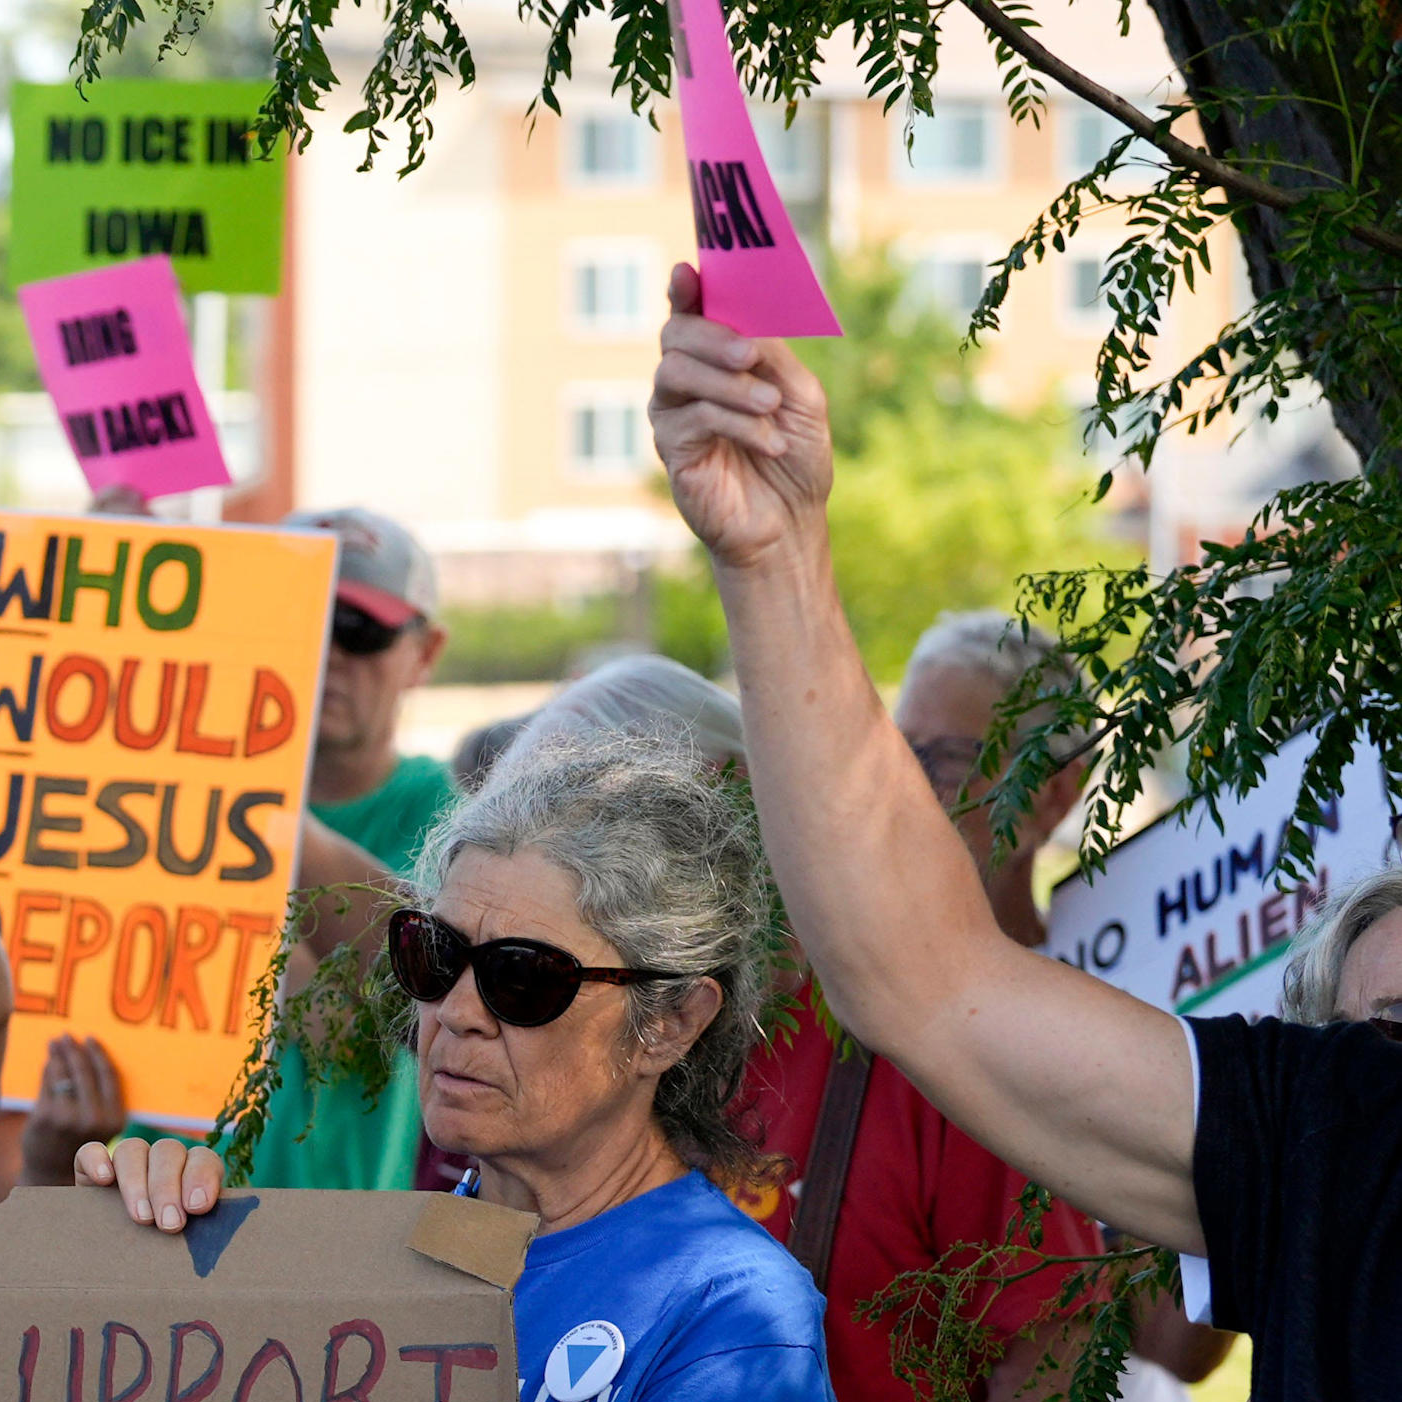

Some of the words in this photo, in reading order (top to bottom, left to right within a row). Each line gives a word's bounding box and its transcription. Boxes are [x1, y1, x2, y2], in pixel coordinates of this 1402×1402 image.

[49, 115, 106, 166] NO
[122, 115, 194, 166] ICE
[85, 207, 210, 260] IOWA
